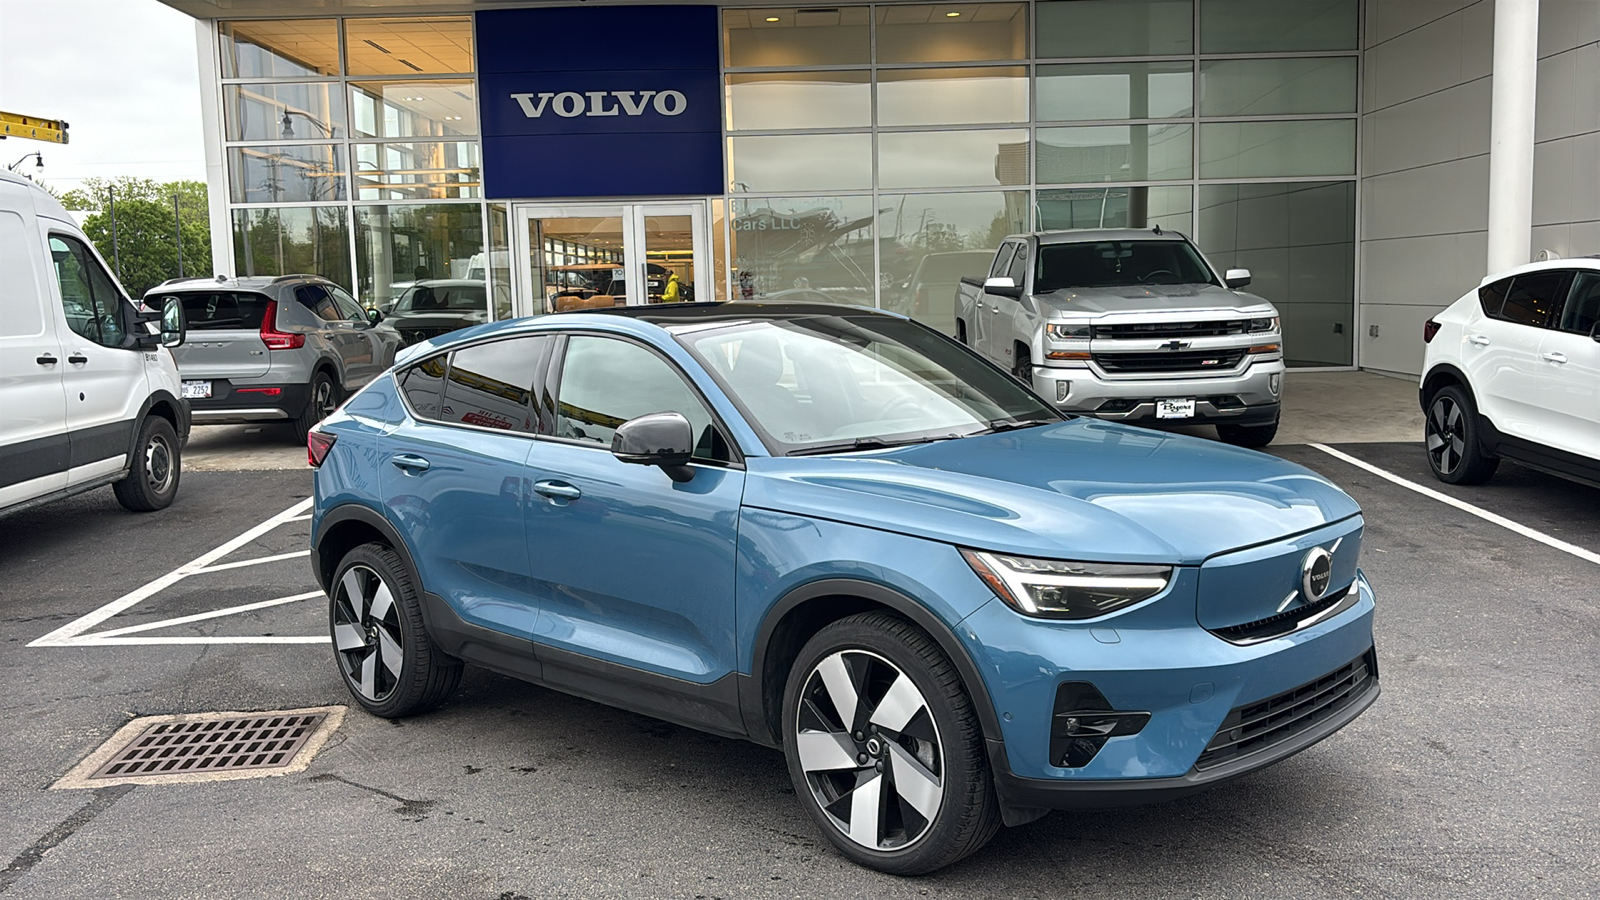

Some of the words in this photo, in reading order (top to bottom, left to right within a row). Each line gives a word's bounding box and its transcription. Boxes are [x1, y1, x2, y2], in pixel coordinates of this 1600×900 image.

[510, 90, 687, 118] VOLVO
[731, 218, 767, 231] Cars
[772, 218, 801, 230] LLC
